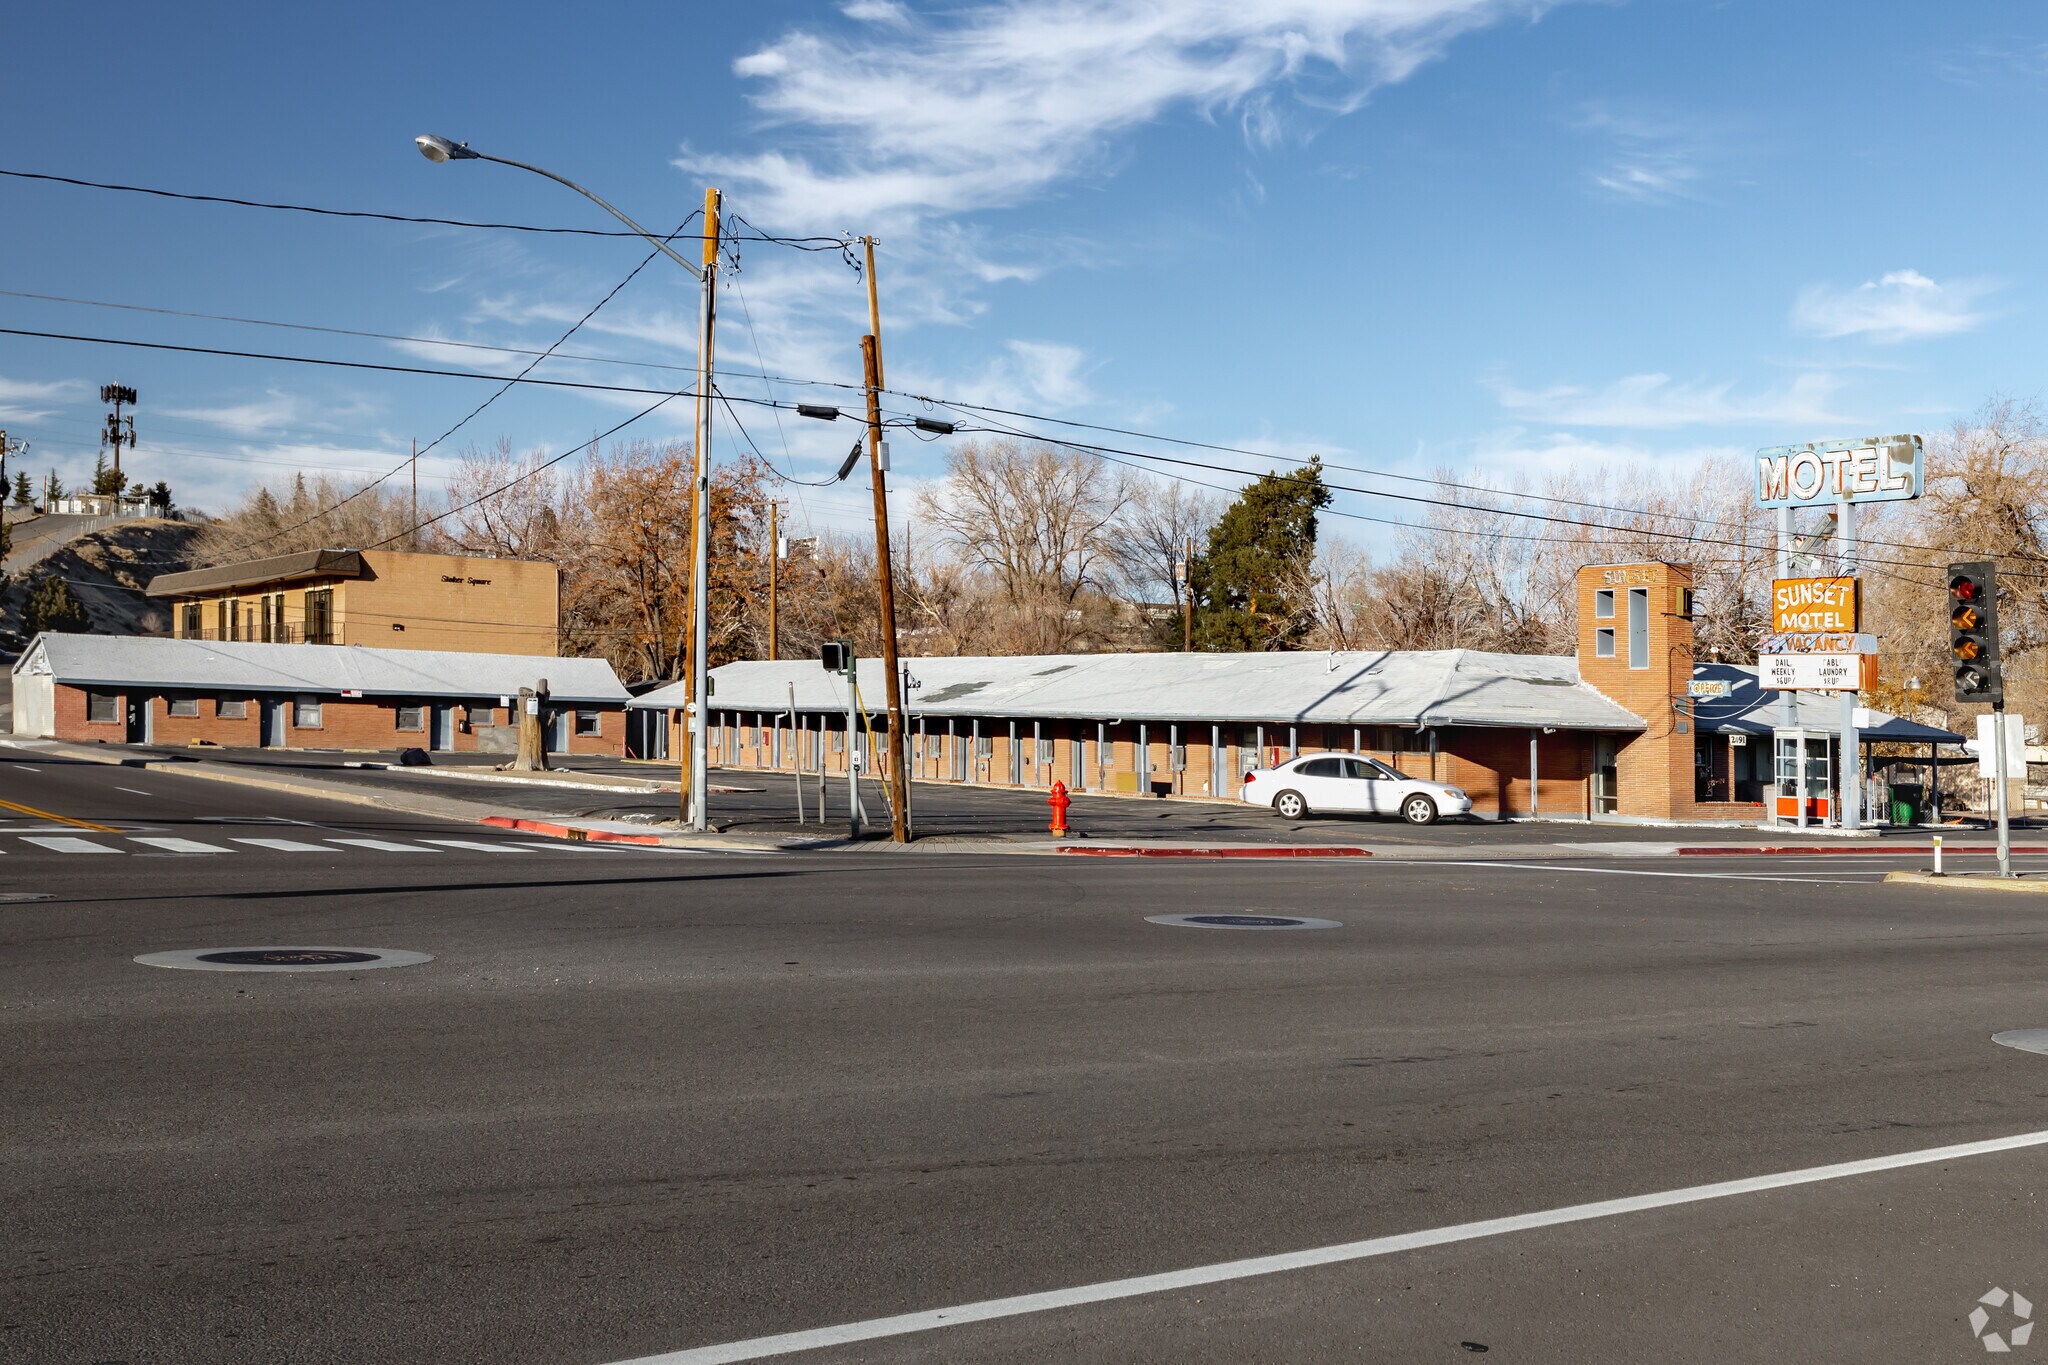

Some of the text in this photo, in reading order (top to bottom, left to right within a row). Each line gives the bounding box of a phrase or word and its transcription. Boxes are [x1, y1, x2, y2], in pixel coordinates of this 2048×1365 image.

[1759, 446, 1907, 501] MOTEL
[1776, 582, 1850, 610] SUNSET
[1781, 611, 1845, 629] MOTEL
[1785, 635, 1856, 652] VACANCY
[1775, 658, 1792, 667] DAIL
[1771, 667, 1796, 676] WEEKLY
[1818, 667, 1848, 676] LAUNDRY
